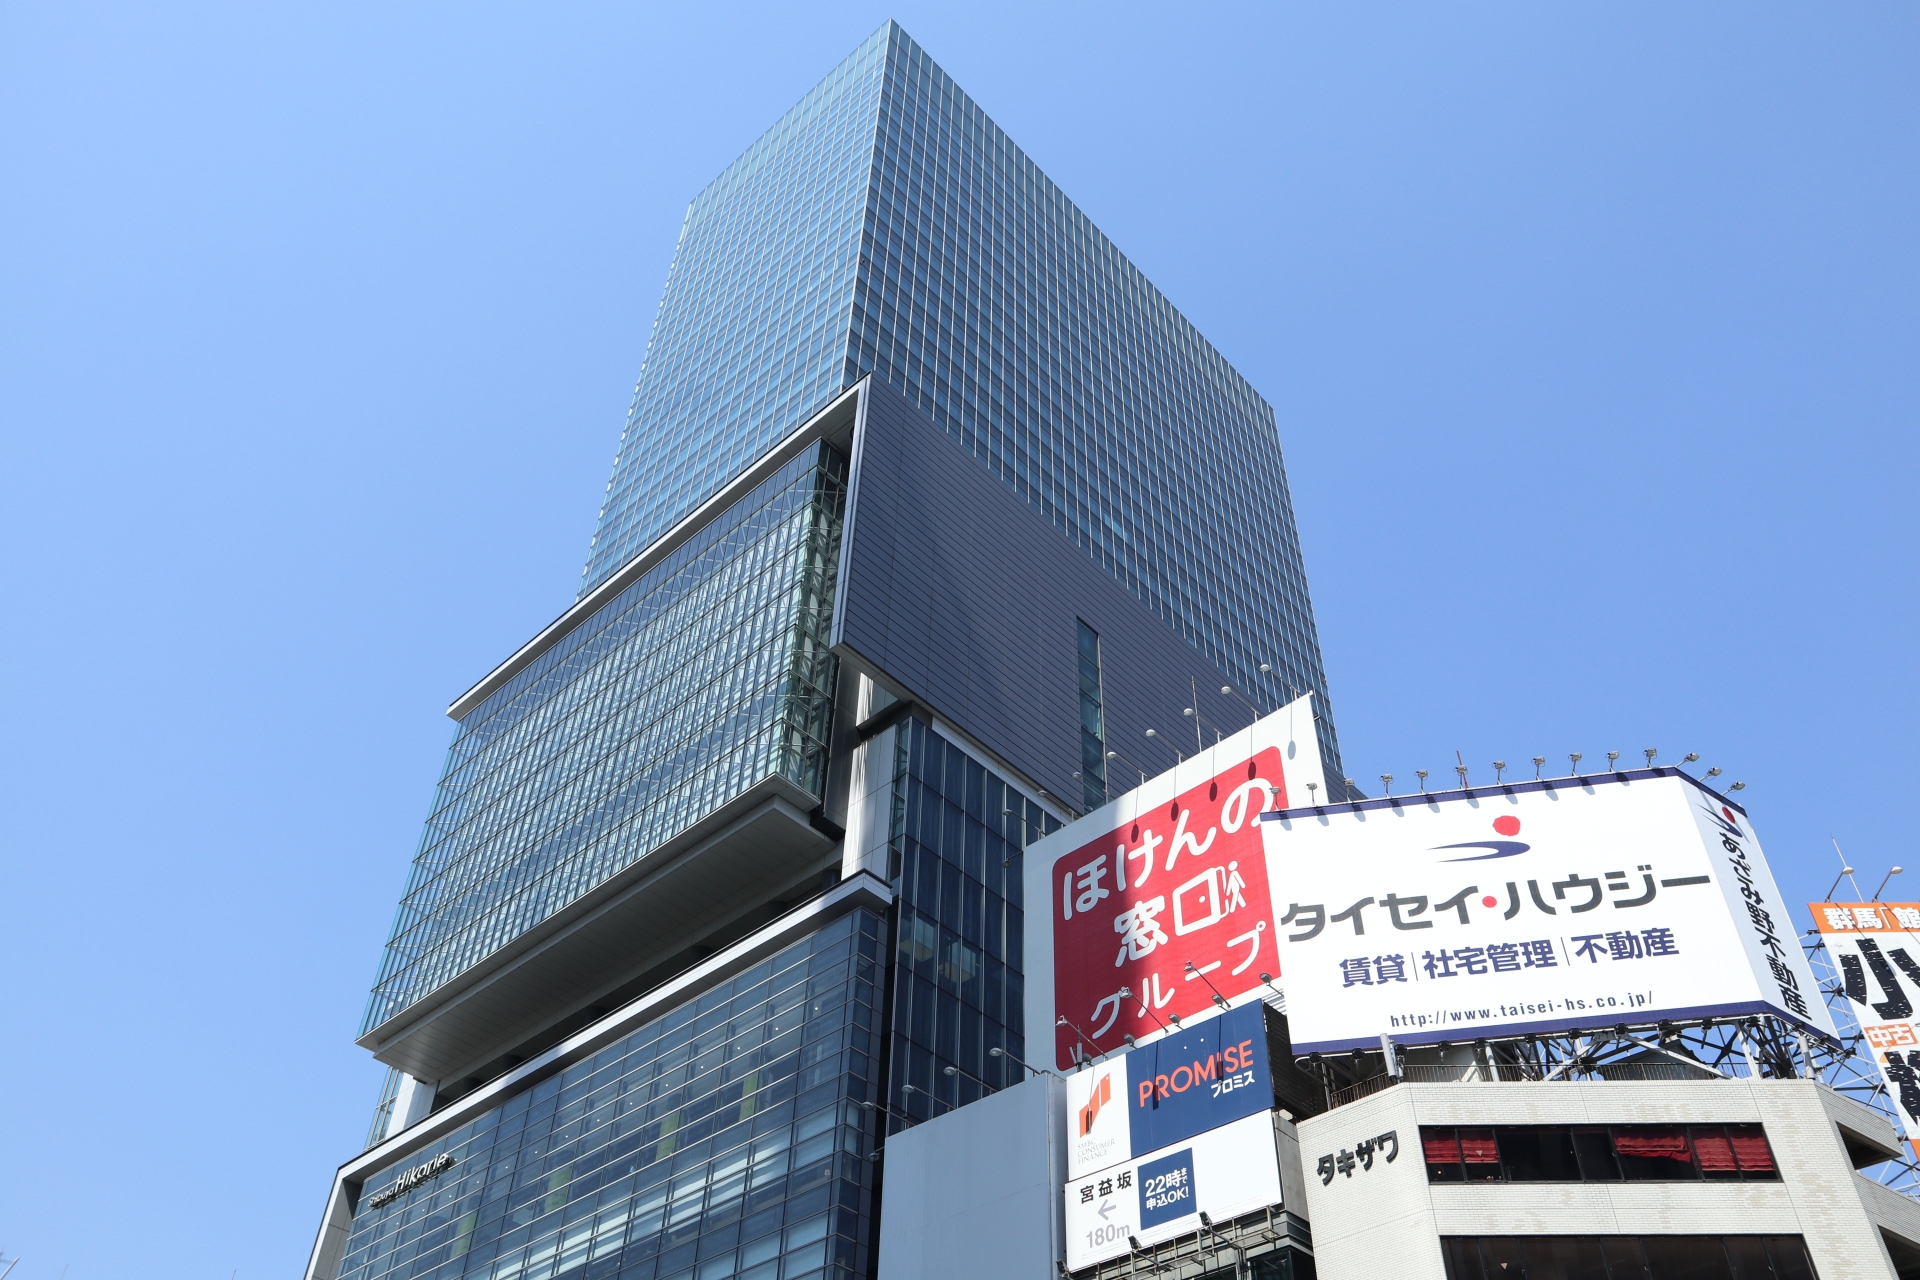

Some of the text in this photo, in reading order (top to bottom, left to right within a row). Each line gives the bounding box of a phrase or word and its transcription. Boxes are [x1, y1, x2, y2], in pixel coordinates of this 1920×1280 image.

[1063, 777, 1274, 921] ほけんの
[1719, 831, 1813, 1021] あざみ野不動産
[1090, 920, 1267, 1040] グループ
[1339, 927, 1680, 988] 賃貸 社宅管理 不動産
[1390, 990, 1652, 1027] http://www.taisei-hs.co.jp/
[1868, 1024, 1915, 1048] 中古
[1138, 1039, 1254, 1108] PROMISE
[1210, 1070, 1256, 1098] プロミス
[394, 1153, 450, 1193] Hikarie
[1317, 1129, 1399, 1187] タキザワ
[1080, 1170, 1132, 1204] 宮益坂
[1086, 1224, 1130, 1249] 180m
